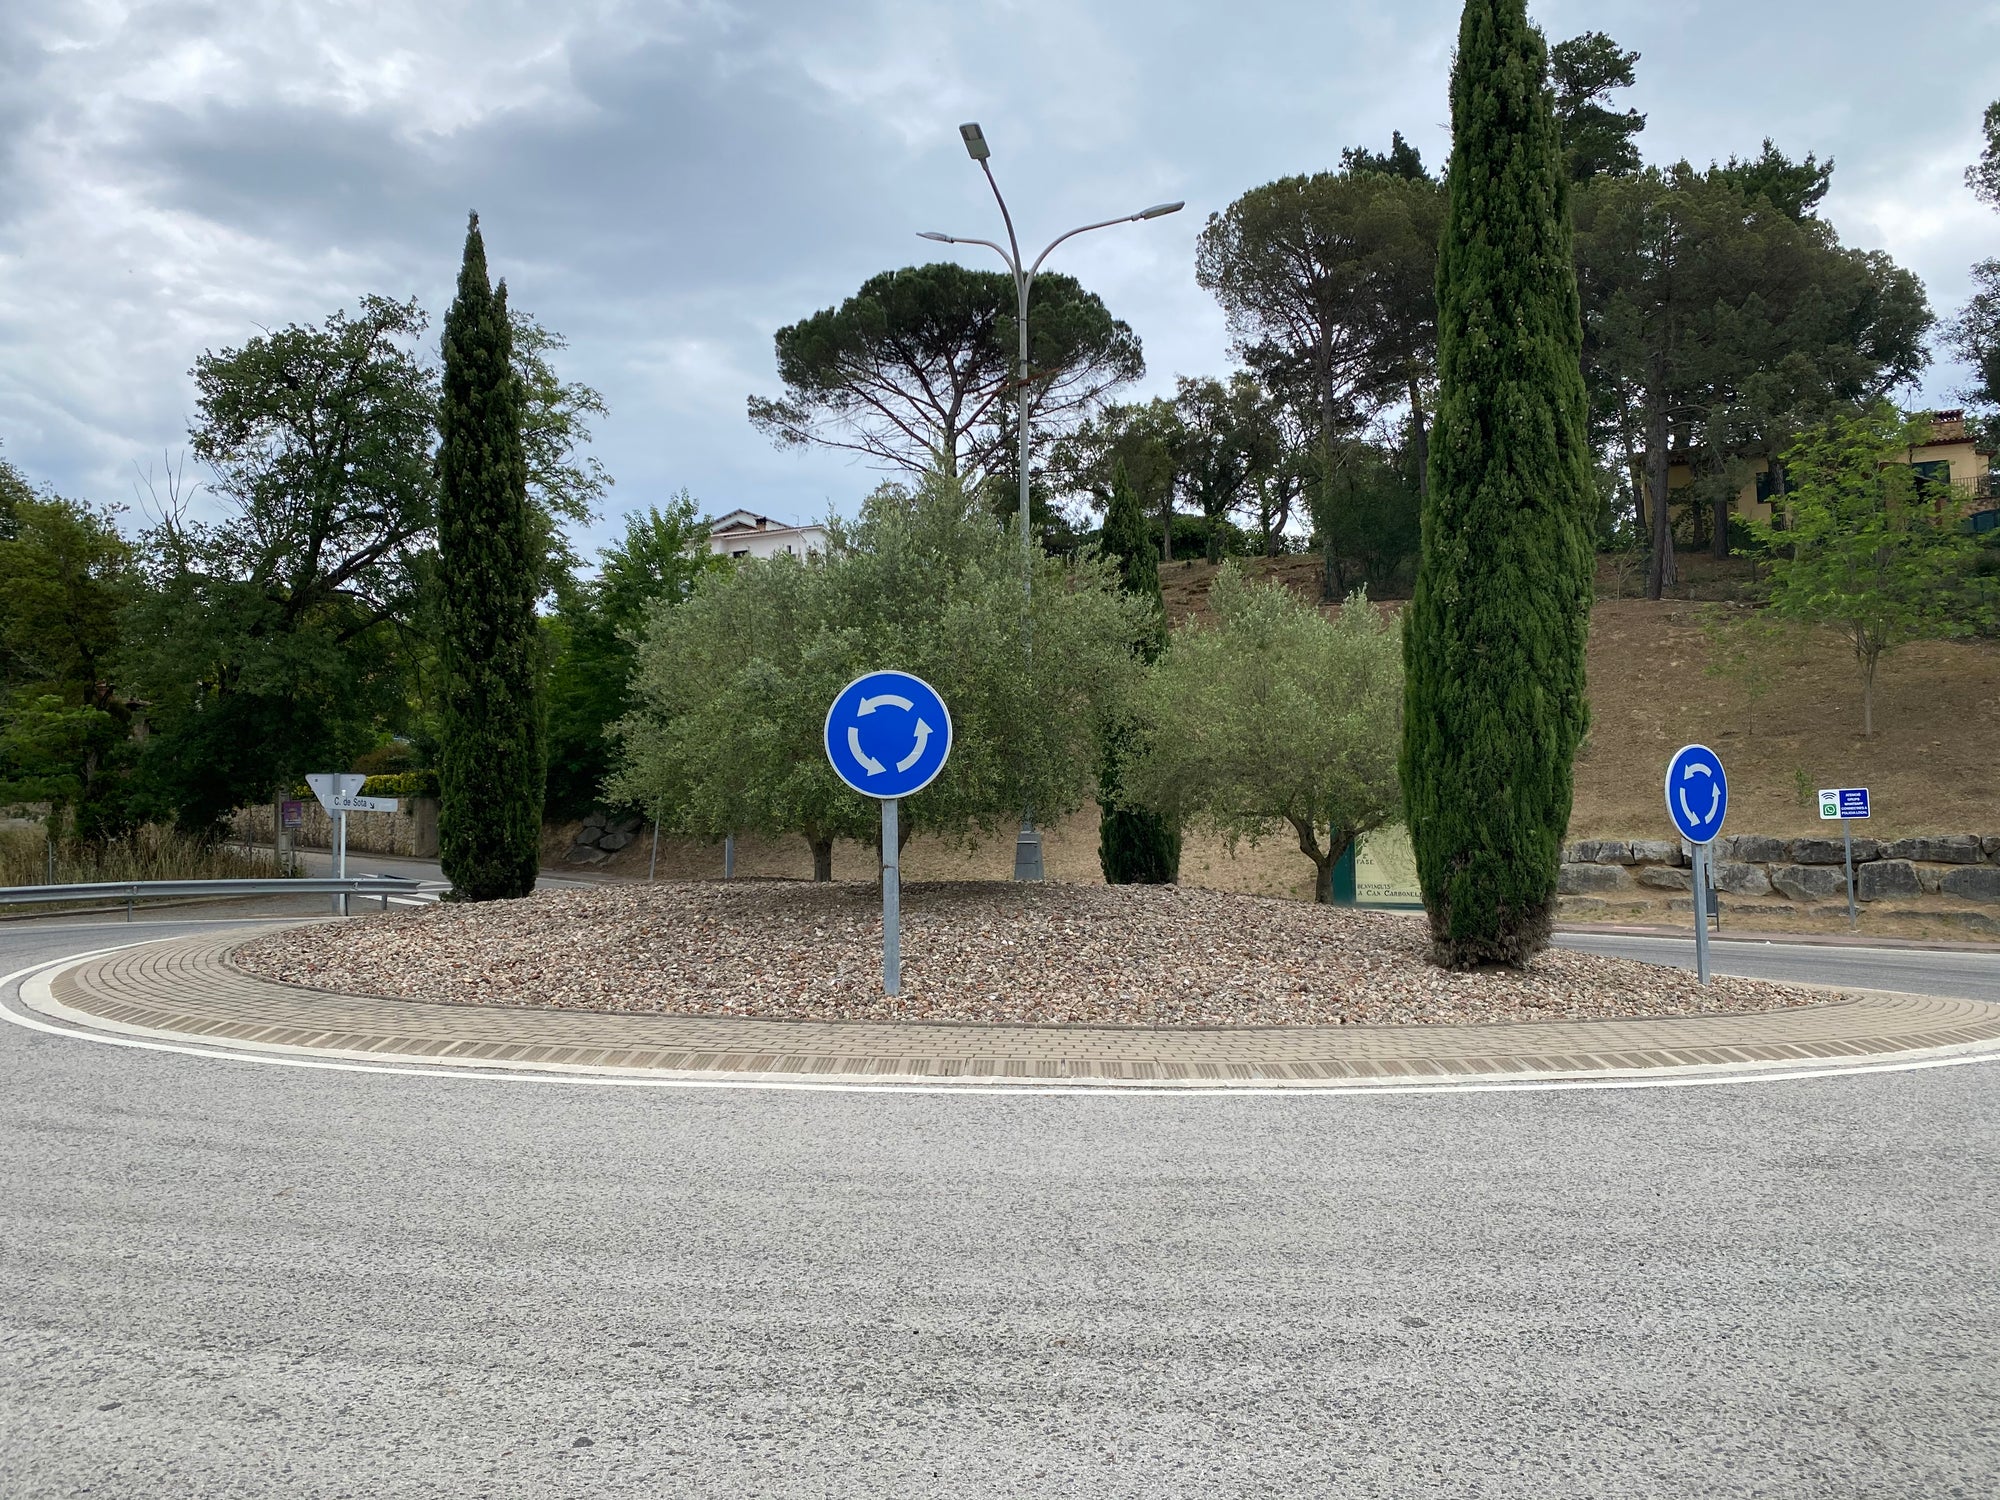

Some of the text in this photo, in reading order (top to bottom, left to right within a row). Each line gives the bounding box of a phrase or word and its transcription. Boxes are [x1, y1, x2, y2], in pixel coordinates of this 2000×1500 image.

[334, 796, 367, 807] C. de Sota
